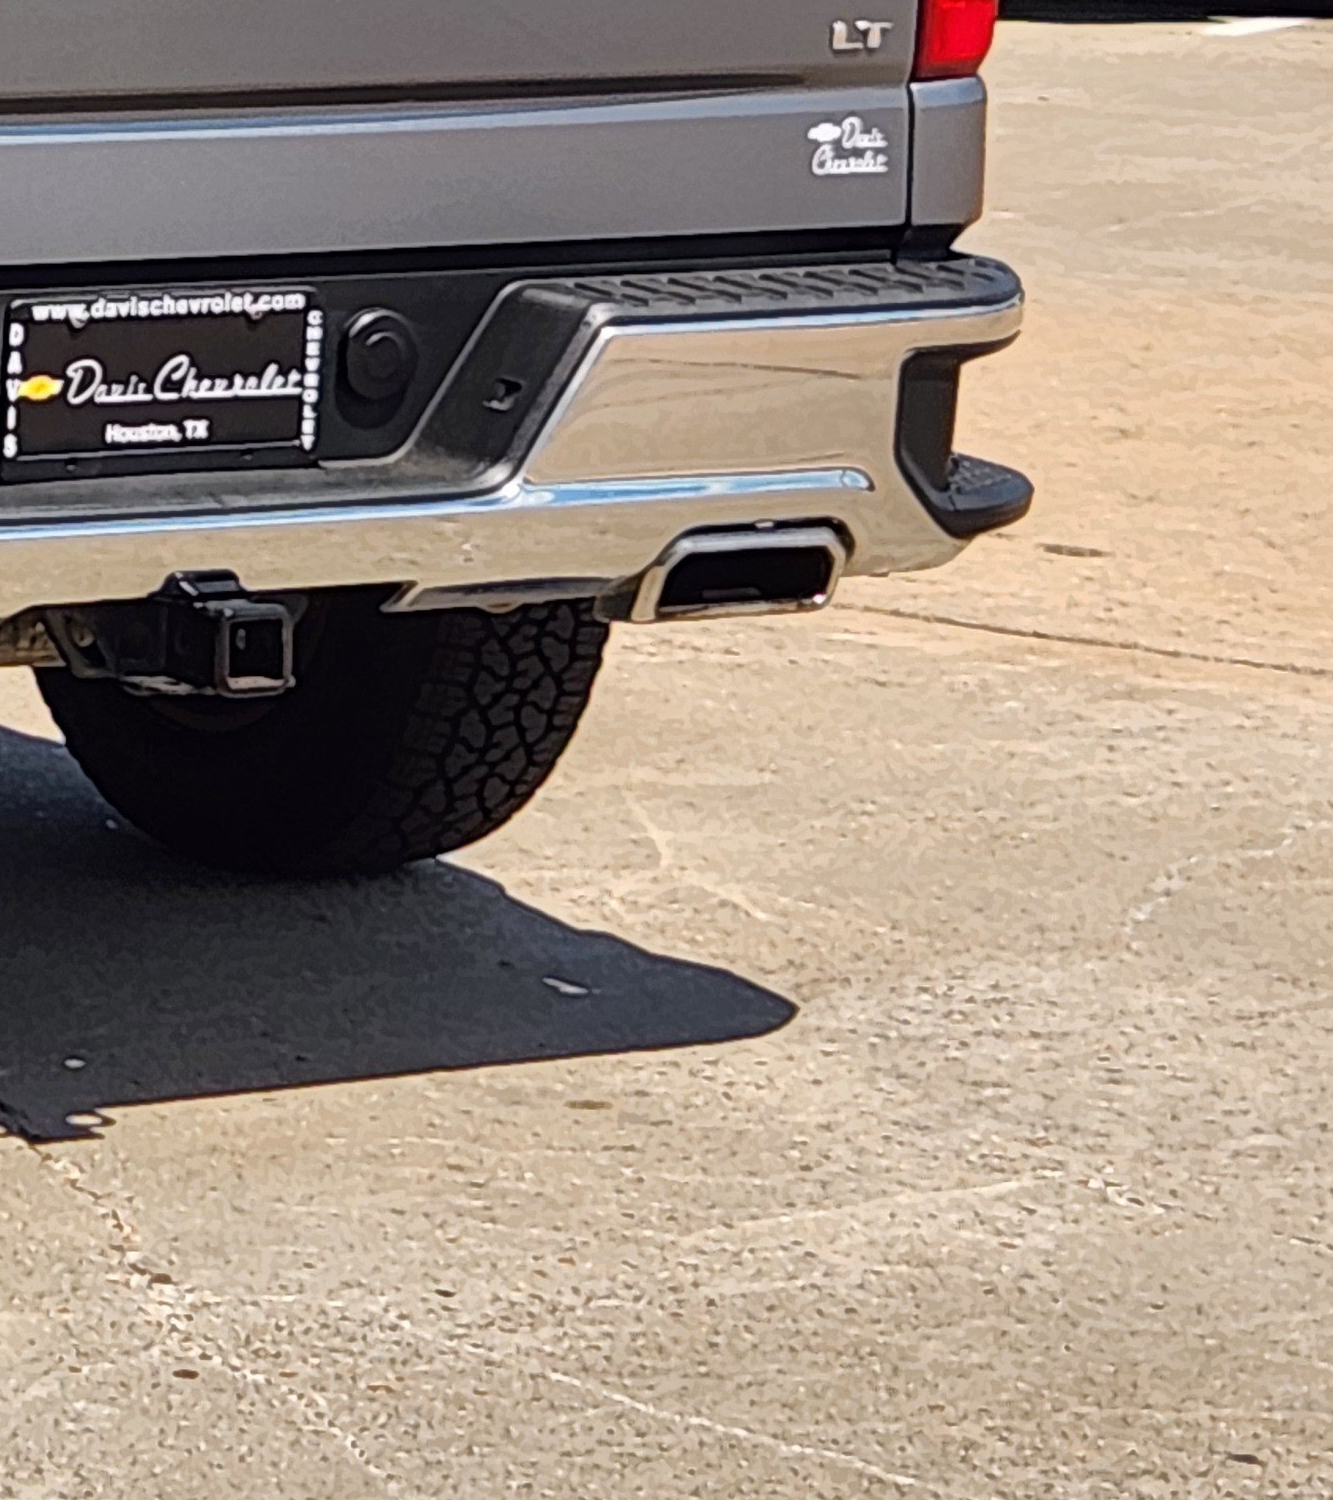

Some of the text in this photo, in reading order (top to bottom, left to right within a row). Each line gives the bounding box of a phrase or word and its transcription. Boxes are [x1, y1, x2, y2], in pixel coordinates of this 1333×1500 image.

[831, 19, 894, 50] LT
[31, 291, 307, 322] www.davischevrolet.com
[3, 322, 25, 458] DAVIS
[66, 353, 303, 405] Davis Chevrolet
[182, 418, 210, 440] TX
